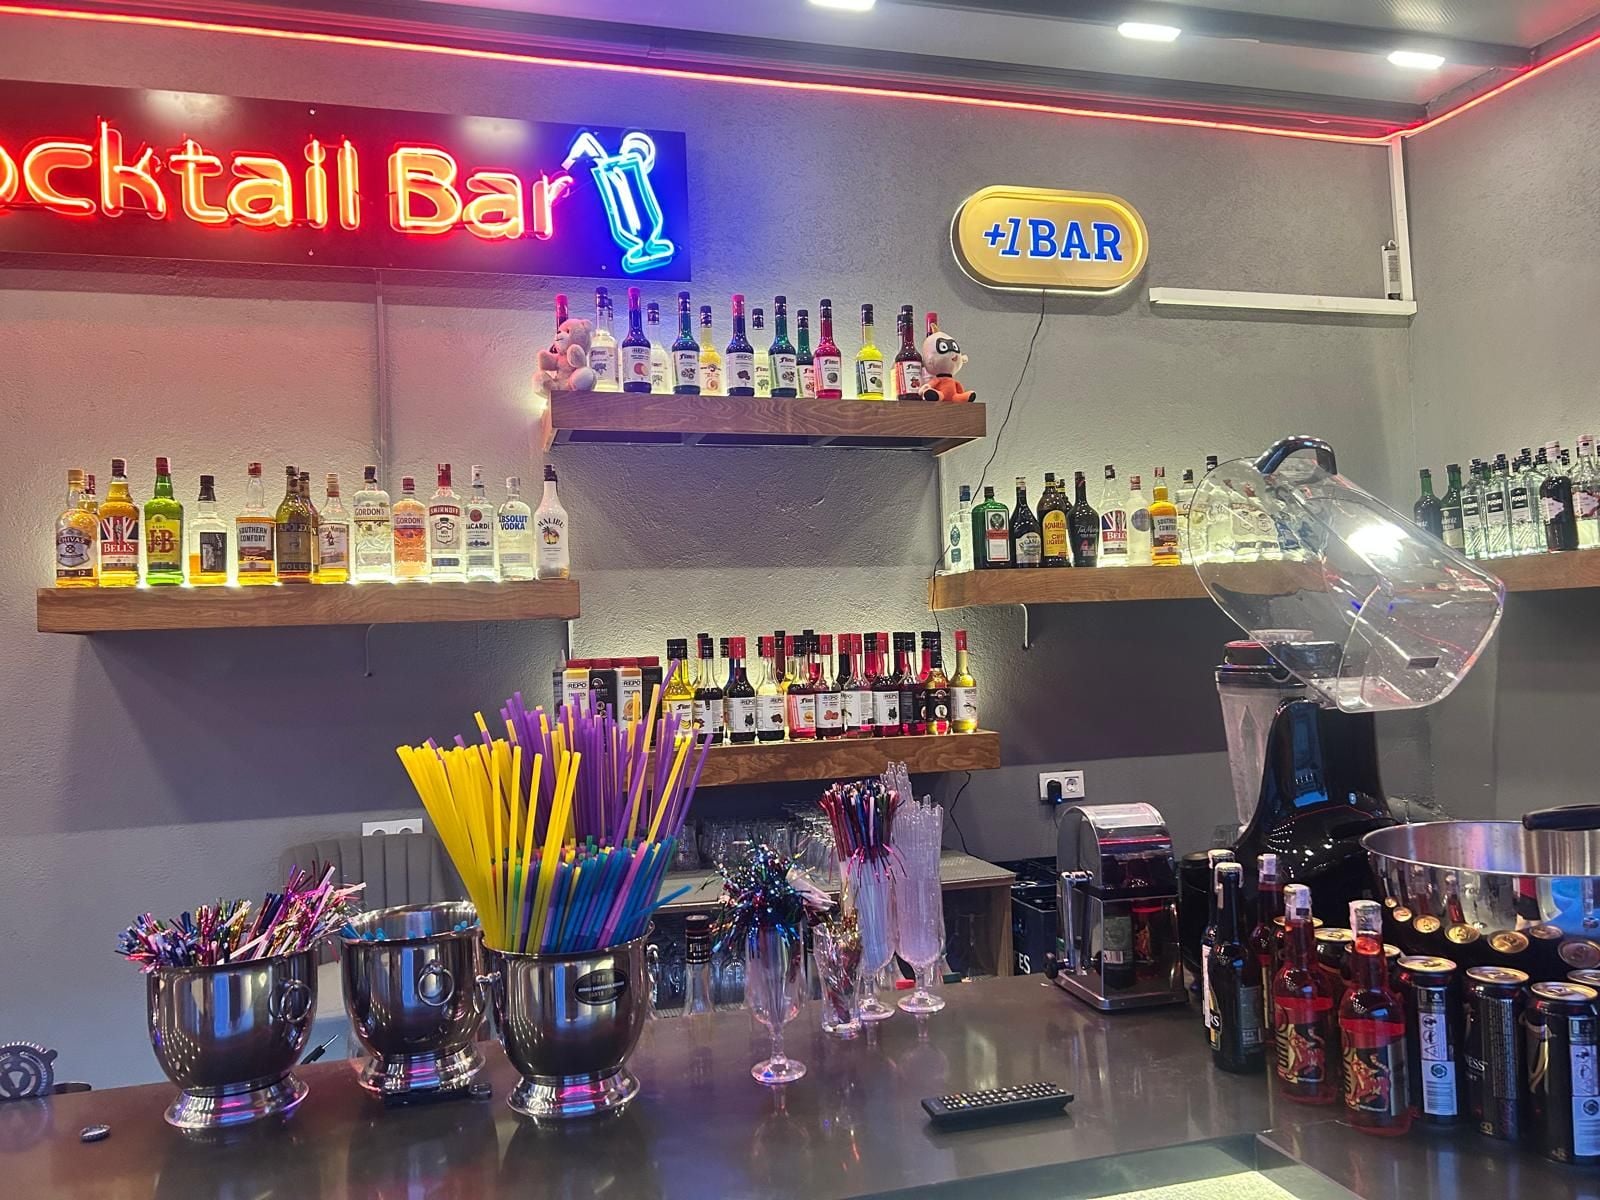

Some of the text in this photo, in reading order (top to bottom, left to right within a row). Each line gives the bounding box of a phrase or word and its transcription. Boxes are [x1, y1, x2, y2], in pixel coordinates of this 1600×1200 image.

[388, 143, 573, 240] Bar
[354, 507, 385, 516] GORDON'S
[430, 505, 459, 515] SMIRNOFF
[499, 515, 528, 523] ABSOLUT
[537, 517, 565, 529] MALIBU
[239, 526, 268, 535] SOUTHERN
[500, 522, 526, 531] VODKA
[240, 534, 266, 542] COMFORT
[104, 543, 135, 553] BELL'S
[568, 681, 587, 689] REPO
